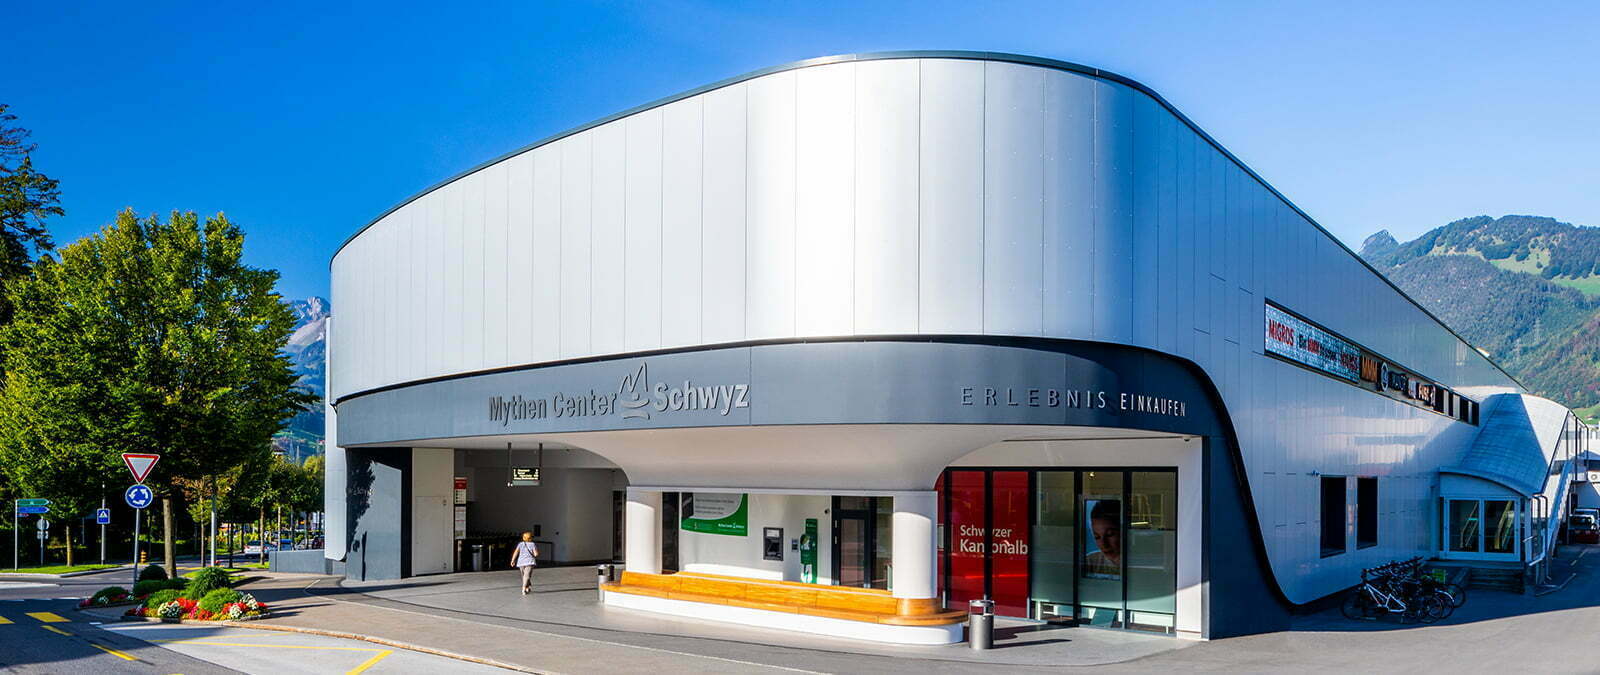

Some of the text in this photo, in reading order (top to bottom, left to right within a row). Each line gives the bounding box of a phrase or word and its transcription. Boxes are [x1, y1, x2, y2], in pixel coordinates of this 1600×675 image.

[488, 380, 750, 426] Mythen Center Schwyz
[961, 387, 1187, 417] ERLEBNIS EINKAUFEN
[959, 538, 1029, 555] Kanonalb
